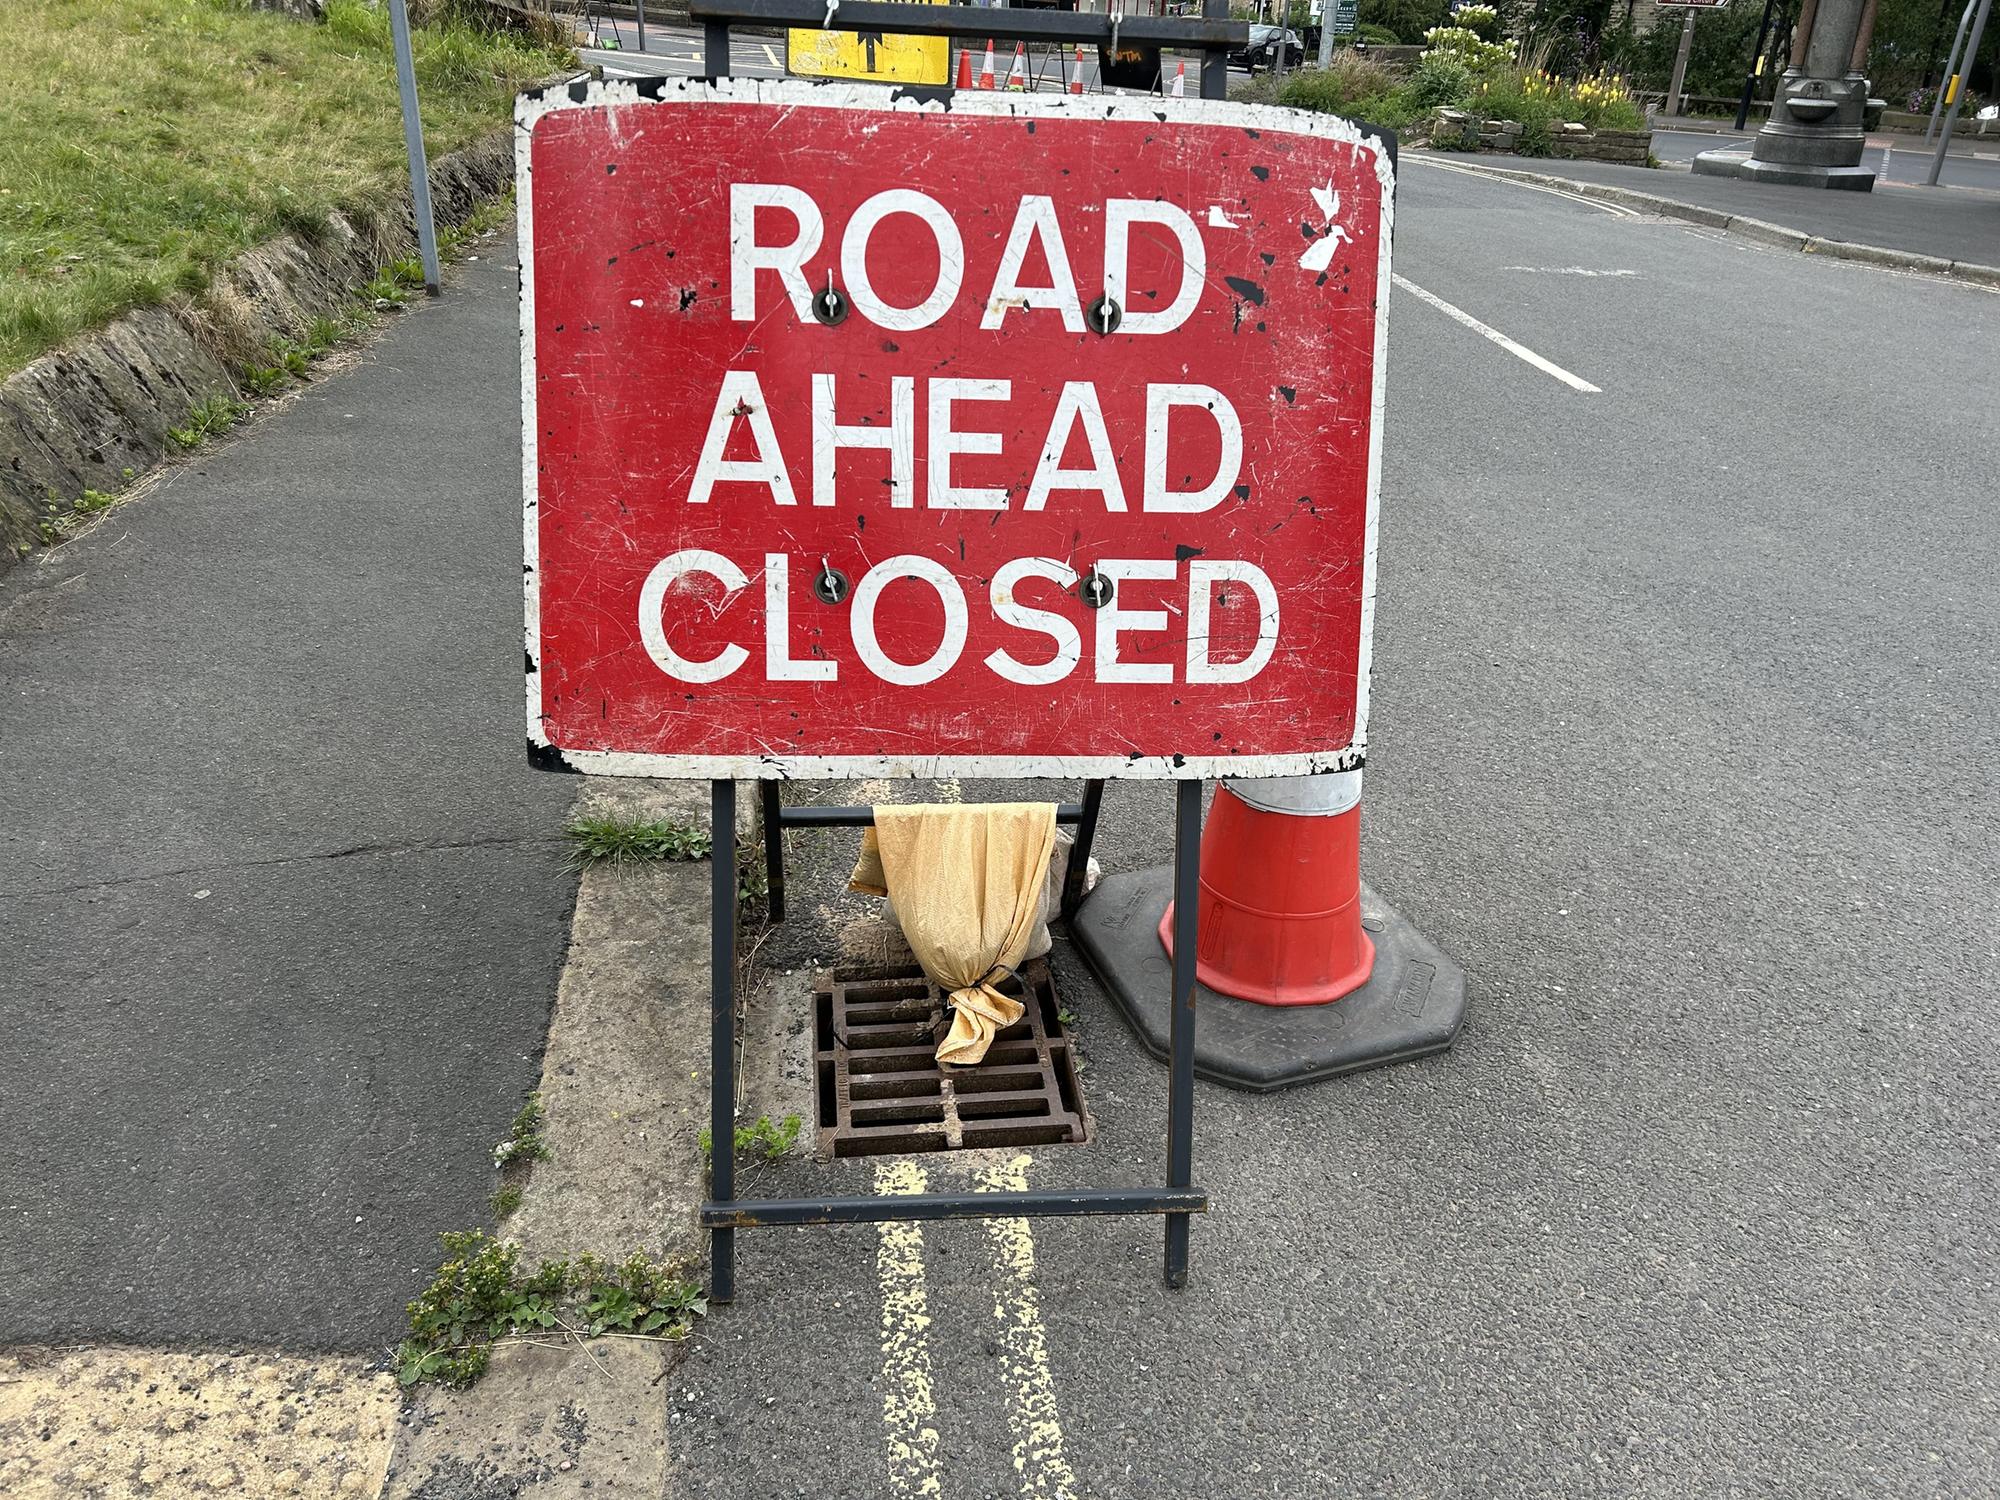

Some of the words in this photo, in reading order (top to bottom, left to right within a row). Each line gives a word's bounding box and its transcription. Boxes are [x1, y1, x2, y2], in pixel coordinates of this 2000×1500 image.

[730, 183, 1206, 335] ROAD
[687, 371, 1244, 514] AHEAD
[638, 548, 1280, 686] CLOSED
